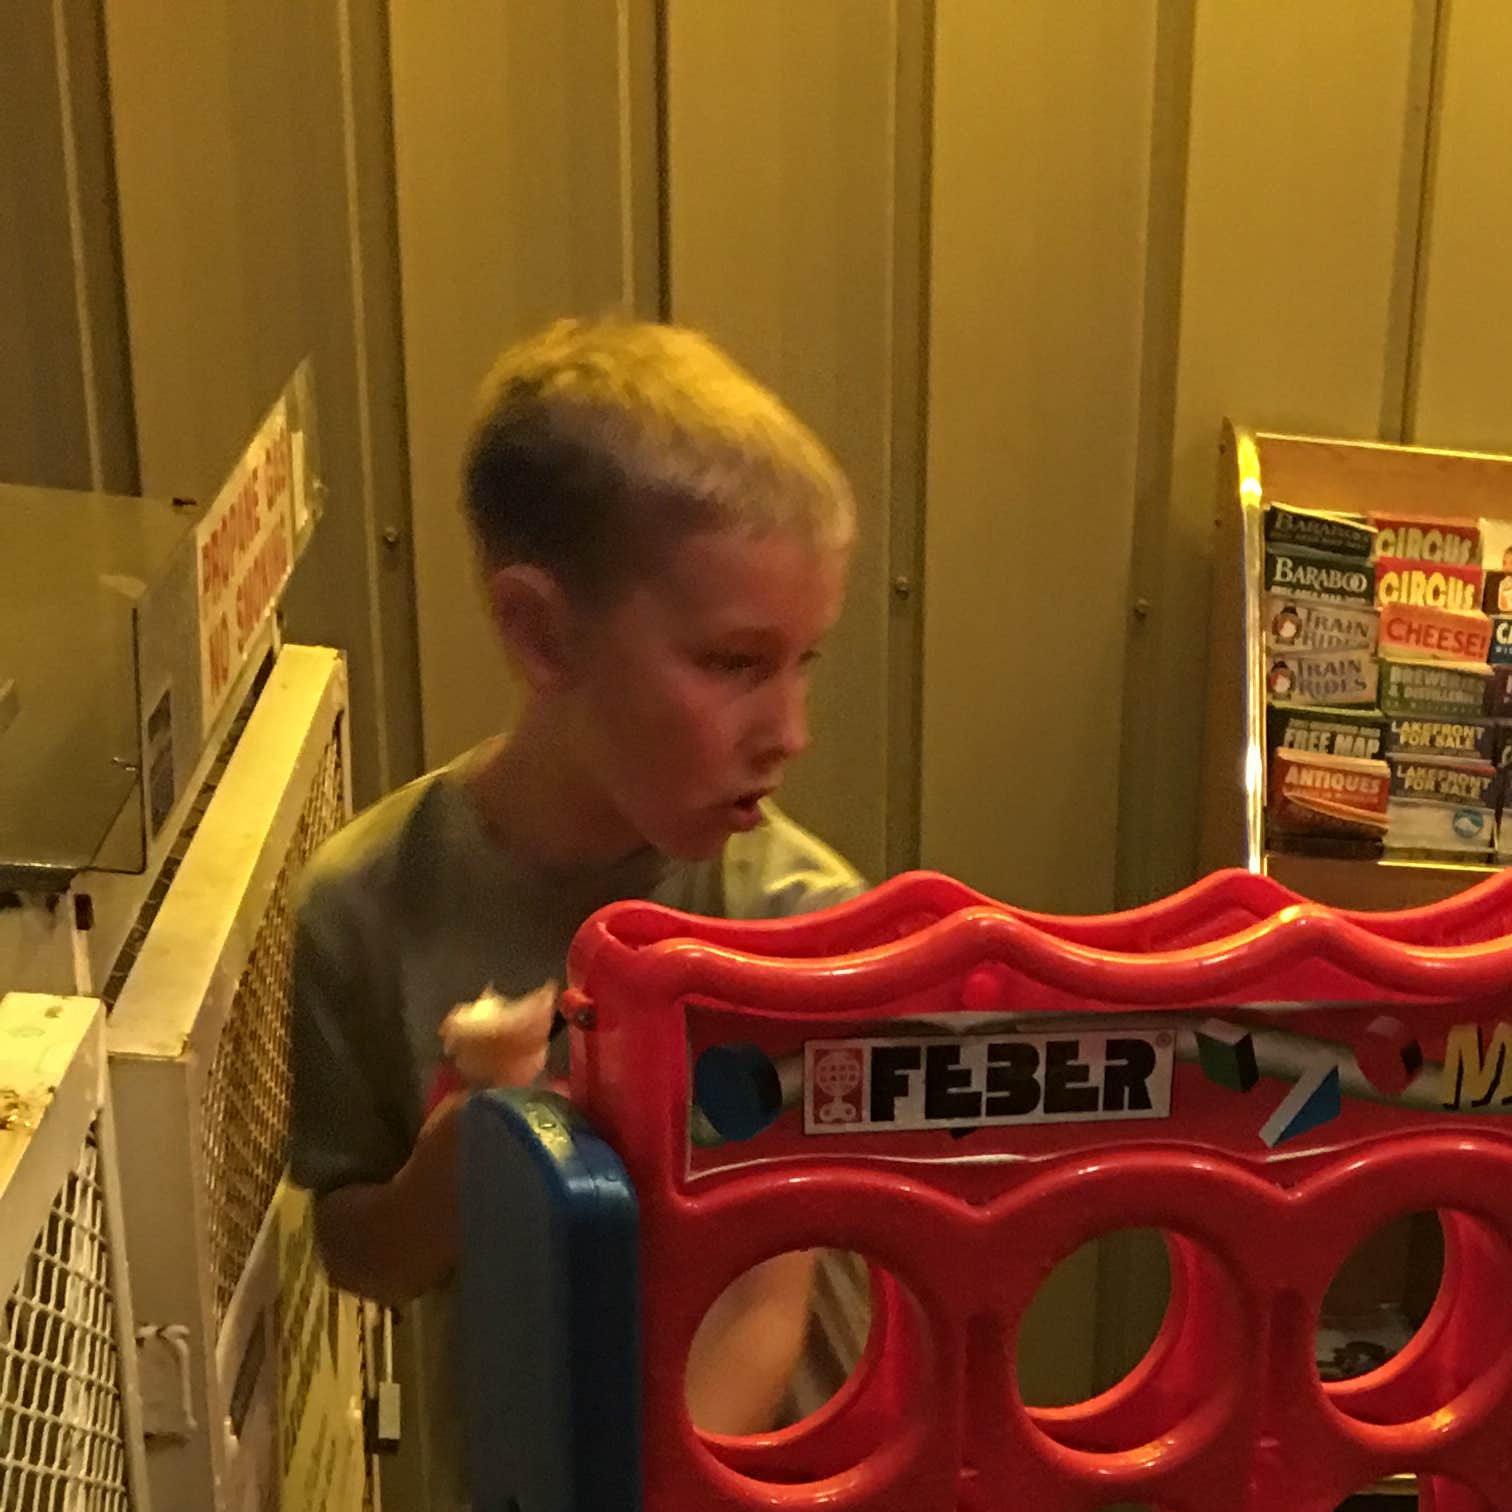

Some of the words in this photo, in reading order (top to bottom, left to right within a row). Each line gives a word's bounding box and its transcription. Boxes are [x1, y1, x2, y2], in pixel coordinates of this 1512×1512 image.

[1375, 527, 1472, 564] CIRCUS
[1274, 556, 1368, 593] BARABOO
[1378, 570, 1475, 610] CIRCUS
[1386, 617, 1487, 658] CHEESE!
[1283, 727, 1331, 754] FREE
[1334, 735, 1380, 760] MAP
[1391, 720, 1486, 740] LAKEFRONT
[1400, 730, 1429, 747] FOR
[1435, 734, 1475, 750] SALE
[1284, 765, 1381, 794] ANTIQUES
[1397, 765, 1492, 790] LAKEFRONT
[1404, 775, 1435, 792] FOR
[1440, 781, 1481, 799] SALE
[870, 1038, 1156, 1122] FEBER
